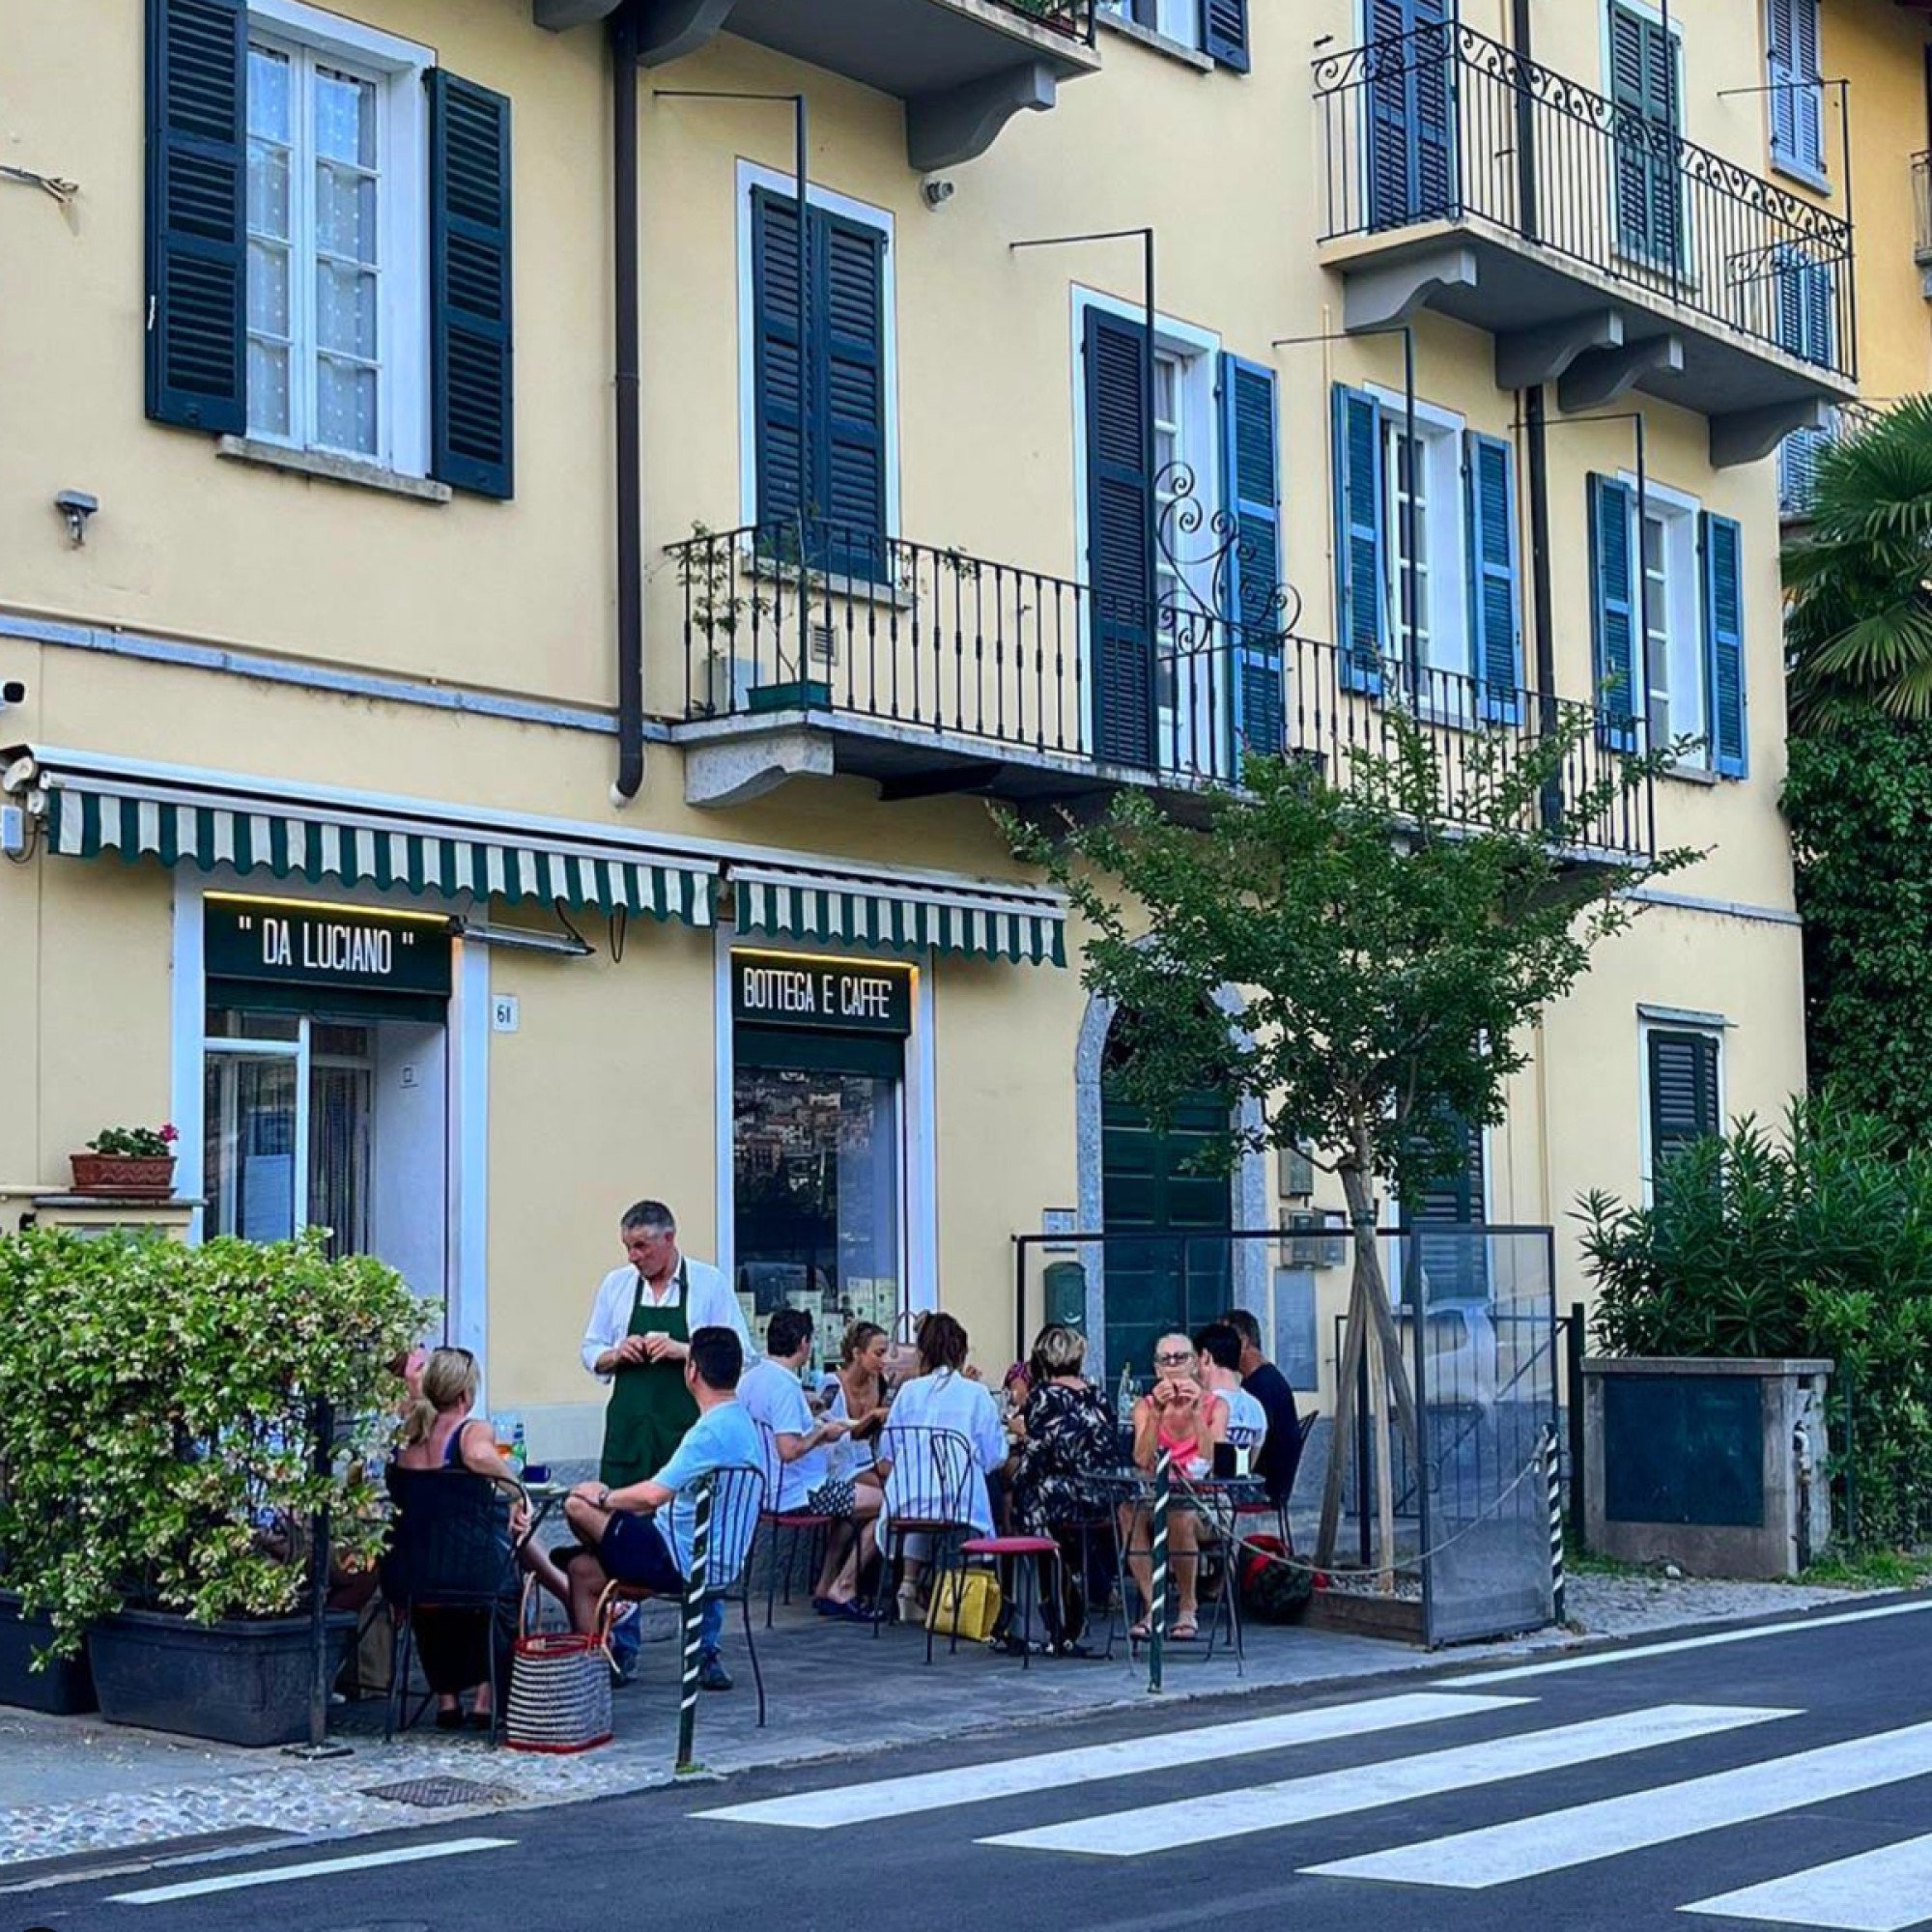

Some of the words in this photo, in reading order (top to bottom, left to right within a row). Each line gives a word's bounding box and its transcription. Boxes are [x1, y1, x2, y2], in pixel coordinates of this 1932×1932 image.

[263, 918, 293, 965] DA
[303, 922, 392, 974] LUCIANO
[497, 1004, 511, 1024] 61
[743, 967, 815, 1012] BOTTEGA
[822, 975, 835, 1014] E
